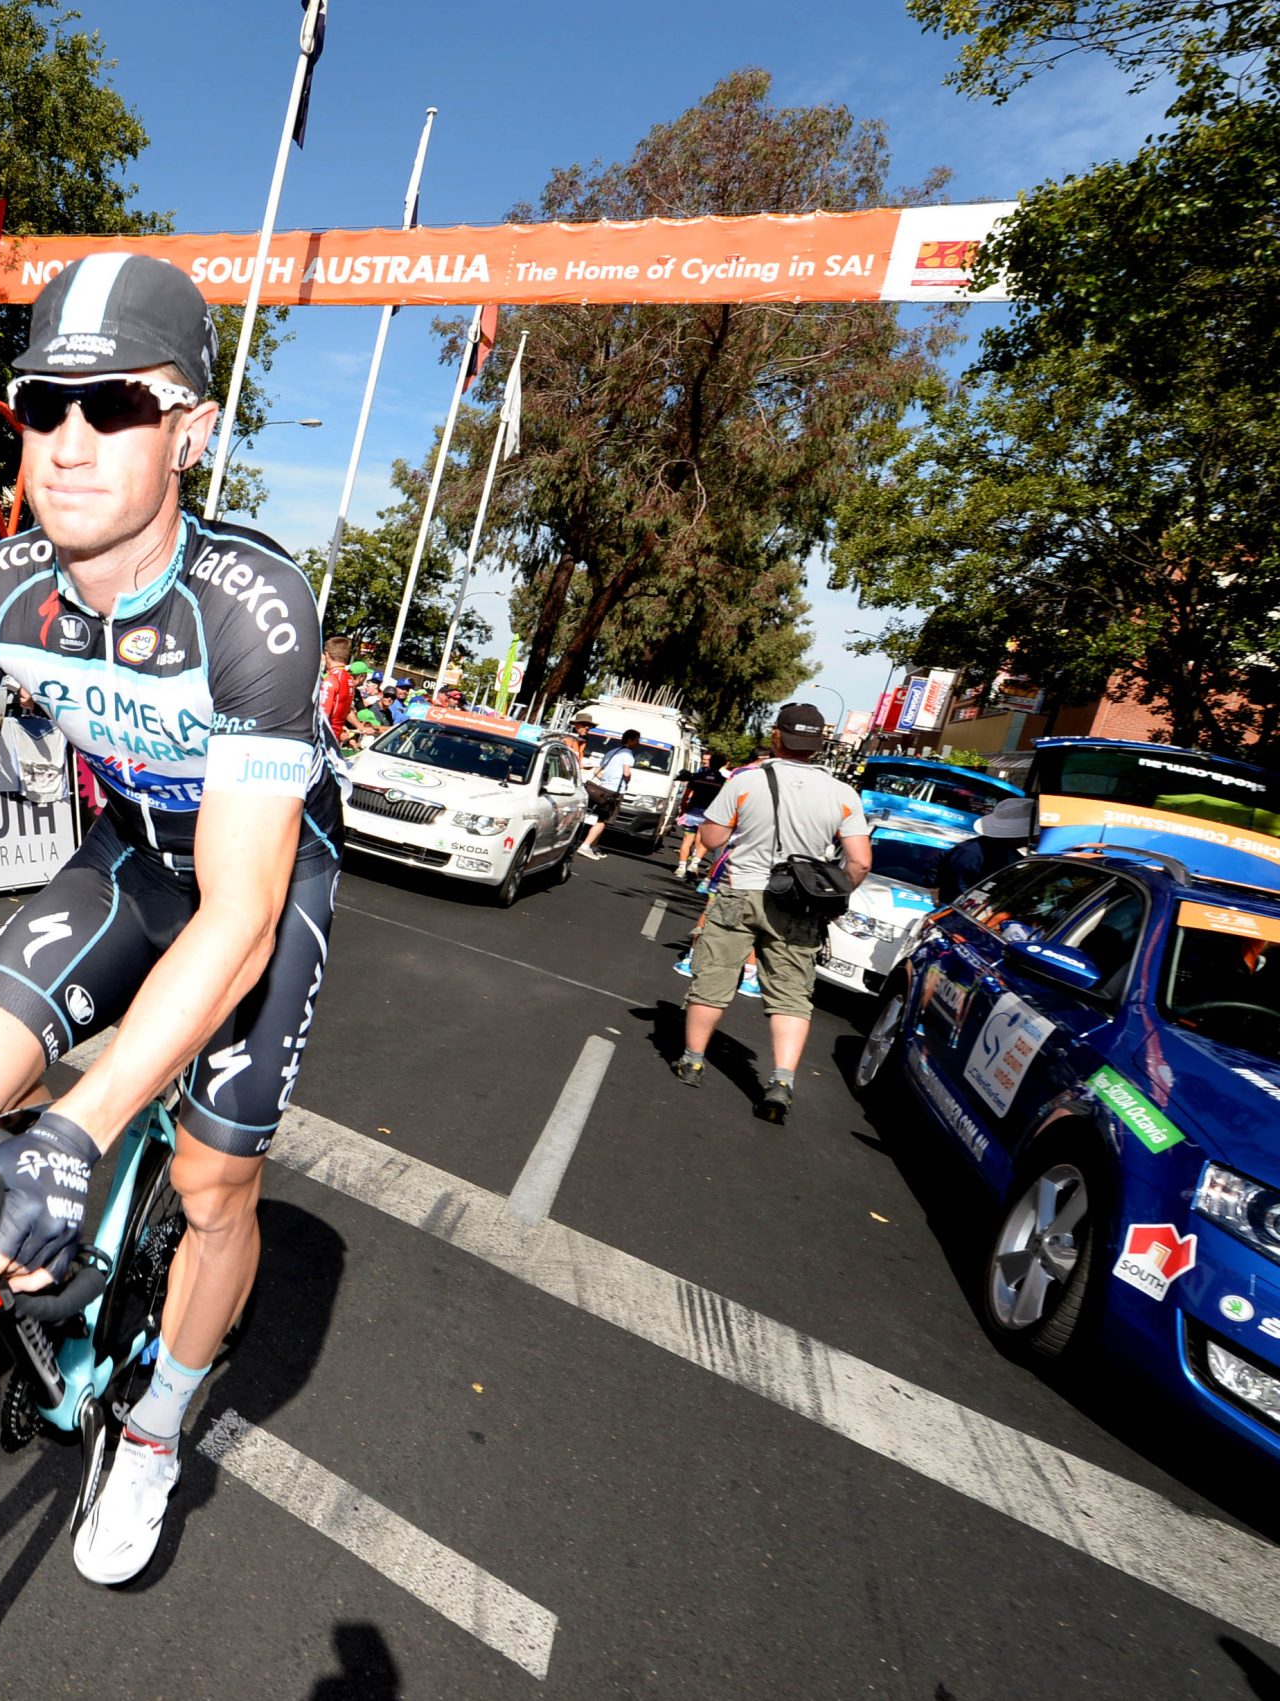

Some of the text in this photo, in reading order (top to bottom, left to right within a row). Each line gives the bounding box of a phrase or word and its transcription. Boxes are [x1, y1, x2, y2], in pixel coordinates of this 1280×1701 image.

[190, 254, 490, 285] SOUTH AUSTRALIA
[516, 253, 876, 285] The Home of Cycling in SA!
[189, 545, 297, 656] latexco
[903, 688, 922, 722] Norwood
[451, 841, 490, 856] ŠKODA
[1103, 810, 1280, 860] CHIEF COMMISSAIRE
[1125, 1105, 1169, 1145] Octavia
[1120, 1258, 1167, 1293] SOUTH
